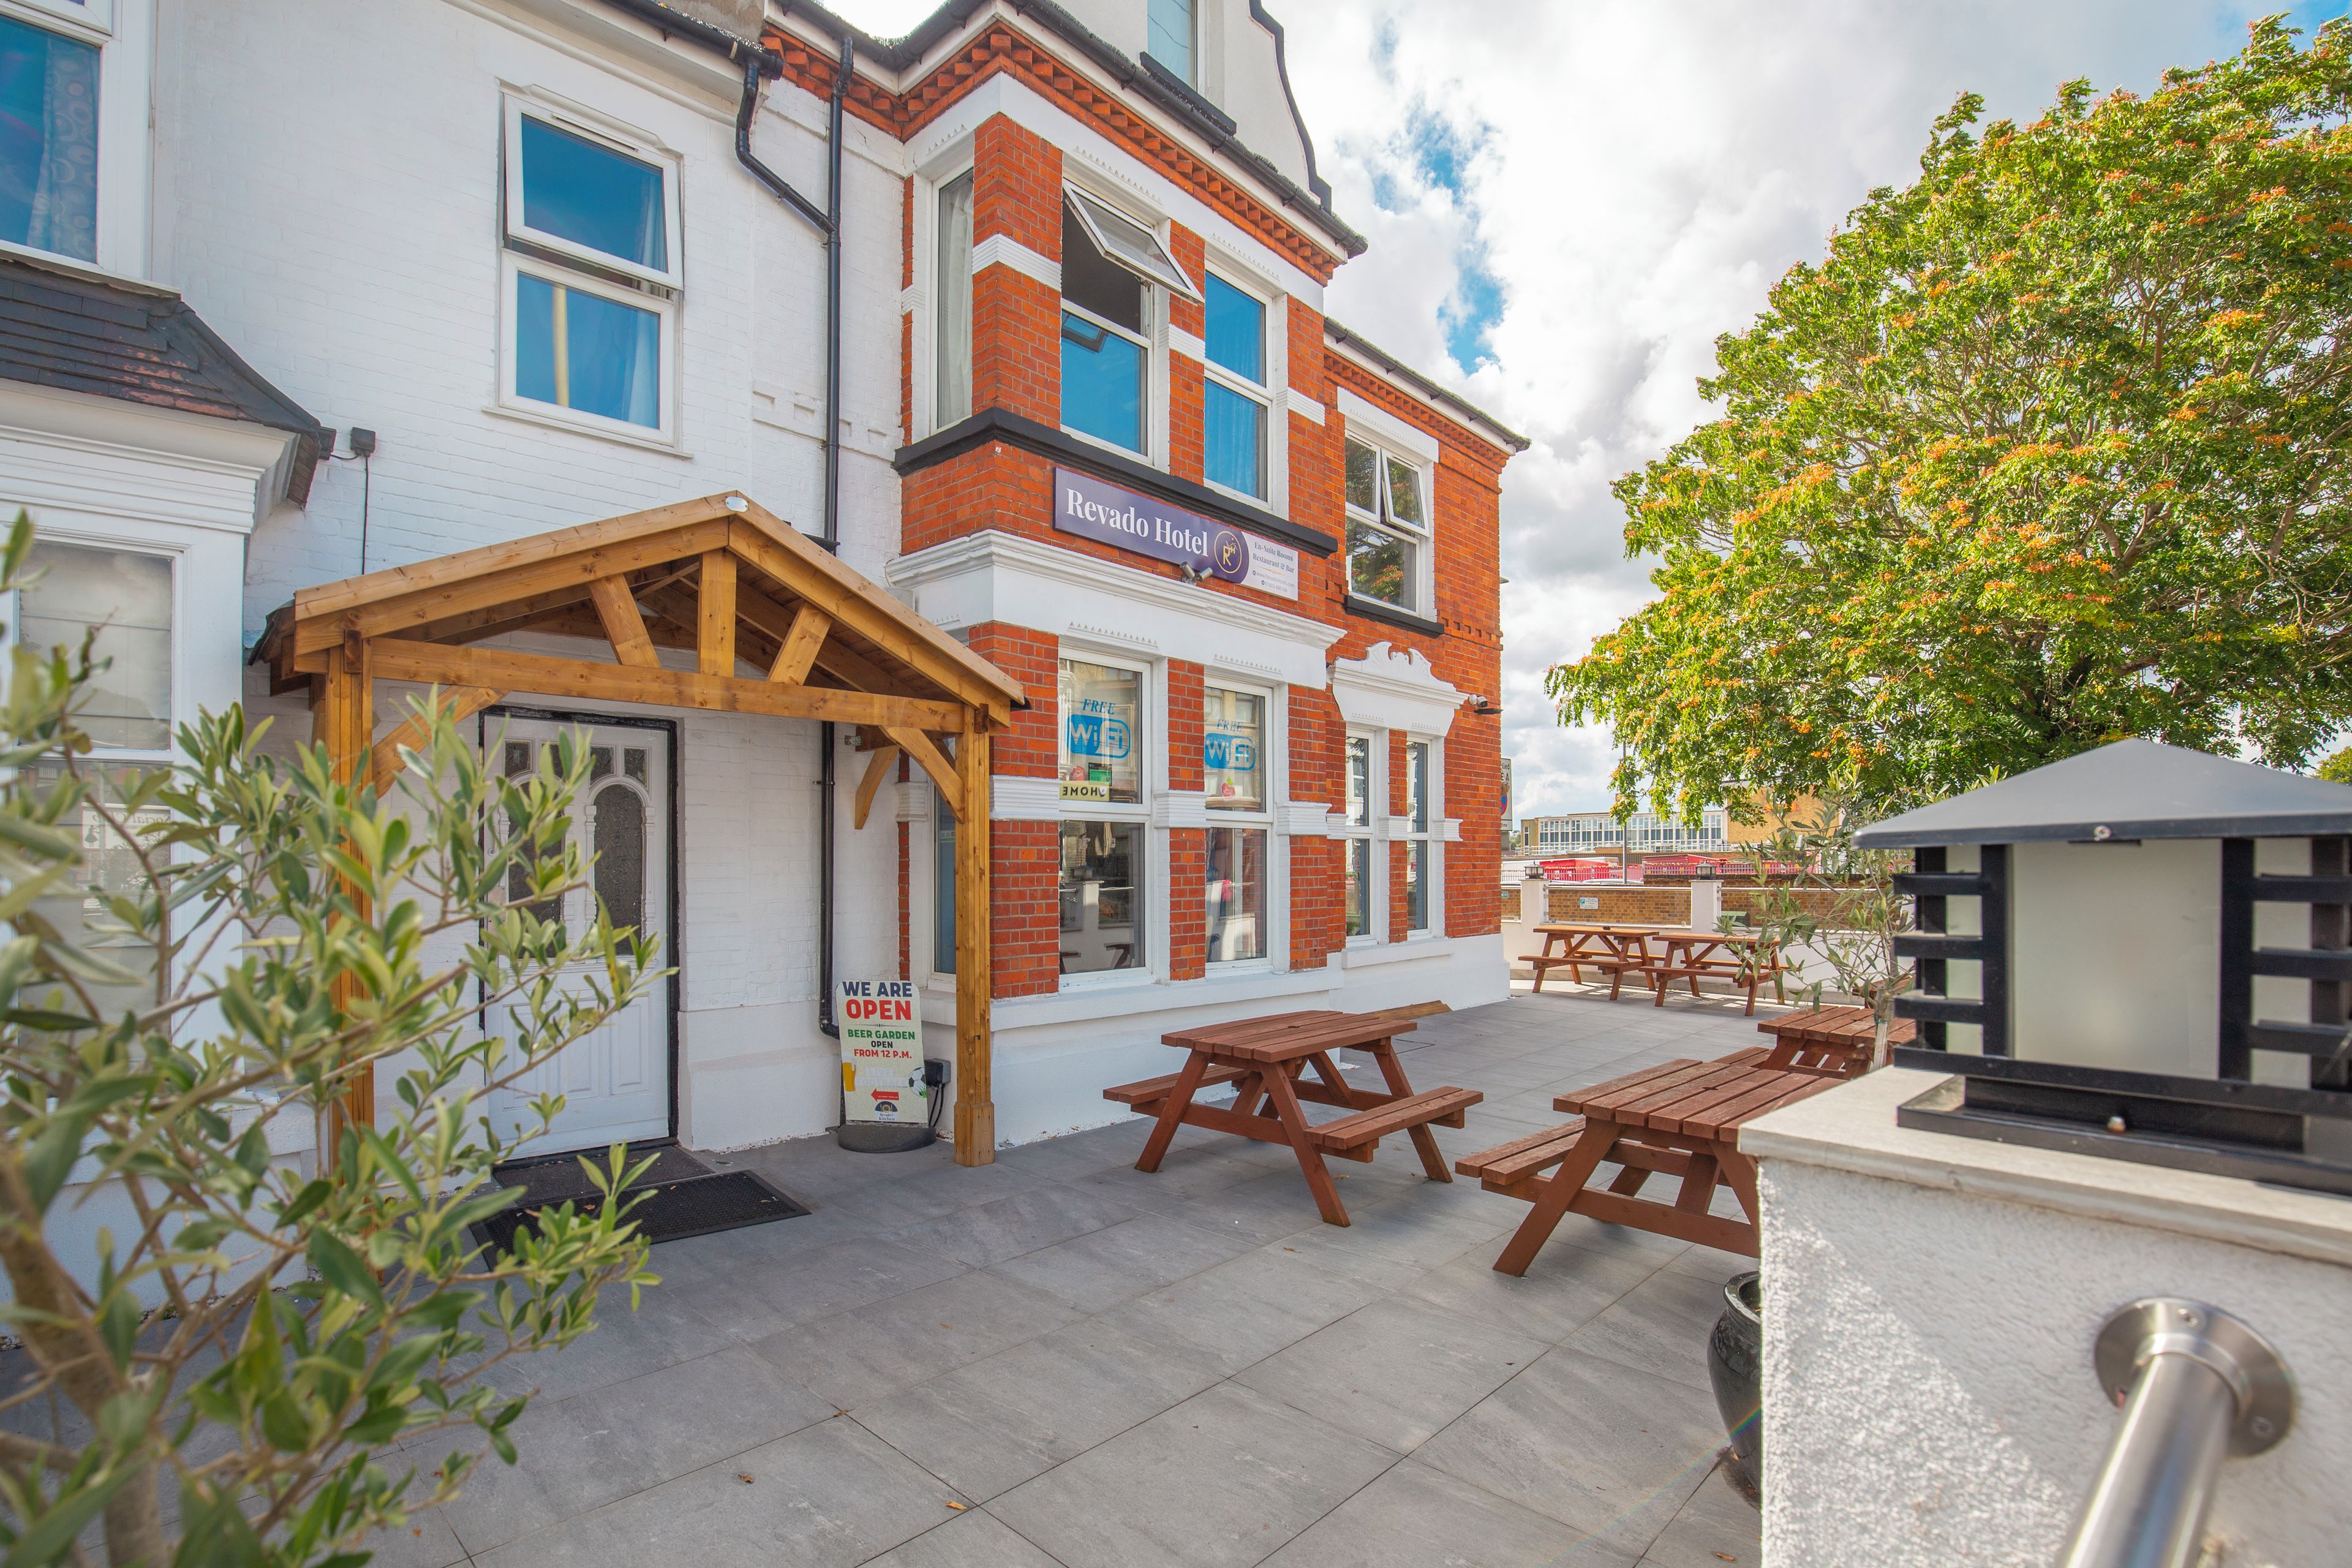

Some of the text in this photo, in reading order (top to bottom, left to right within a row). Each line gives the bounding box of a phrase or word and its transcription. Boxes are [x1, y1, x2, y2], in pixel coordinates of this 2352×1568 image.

[1066, 488, 1208, 557] Revado Hotel
[1254, 541, 1293, 562] En-Suite Rooms
[1253, 552, 1280, 568] Restaurant
[1286, 564, 1295, 573] Bar
[1082, 698, 1116, 715] FREE
[1216, 719, 1243, 732] FREE
[842, 981, 912, 997] WE ARE
[846, 999, 911, 1020] OPEN
[848, 1029, 915, 1039] BEER GARDEN
[854, 1049, 878, 1057] FROM
[892, 1050, 912, 1058] P.M.
